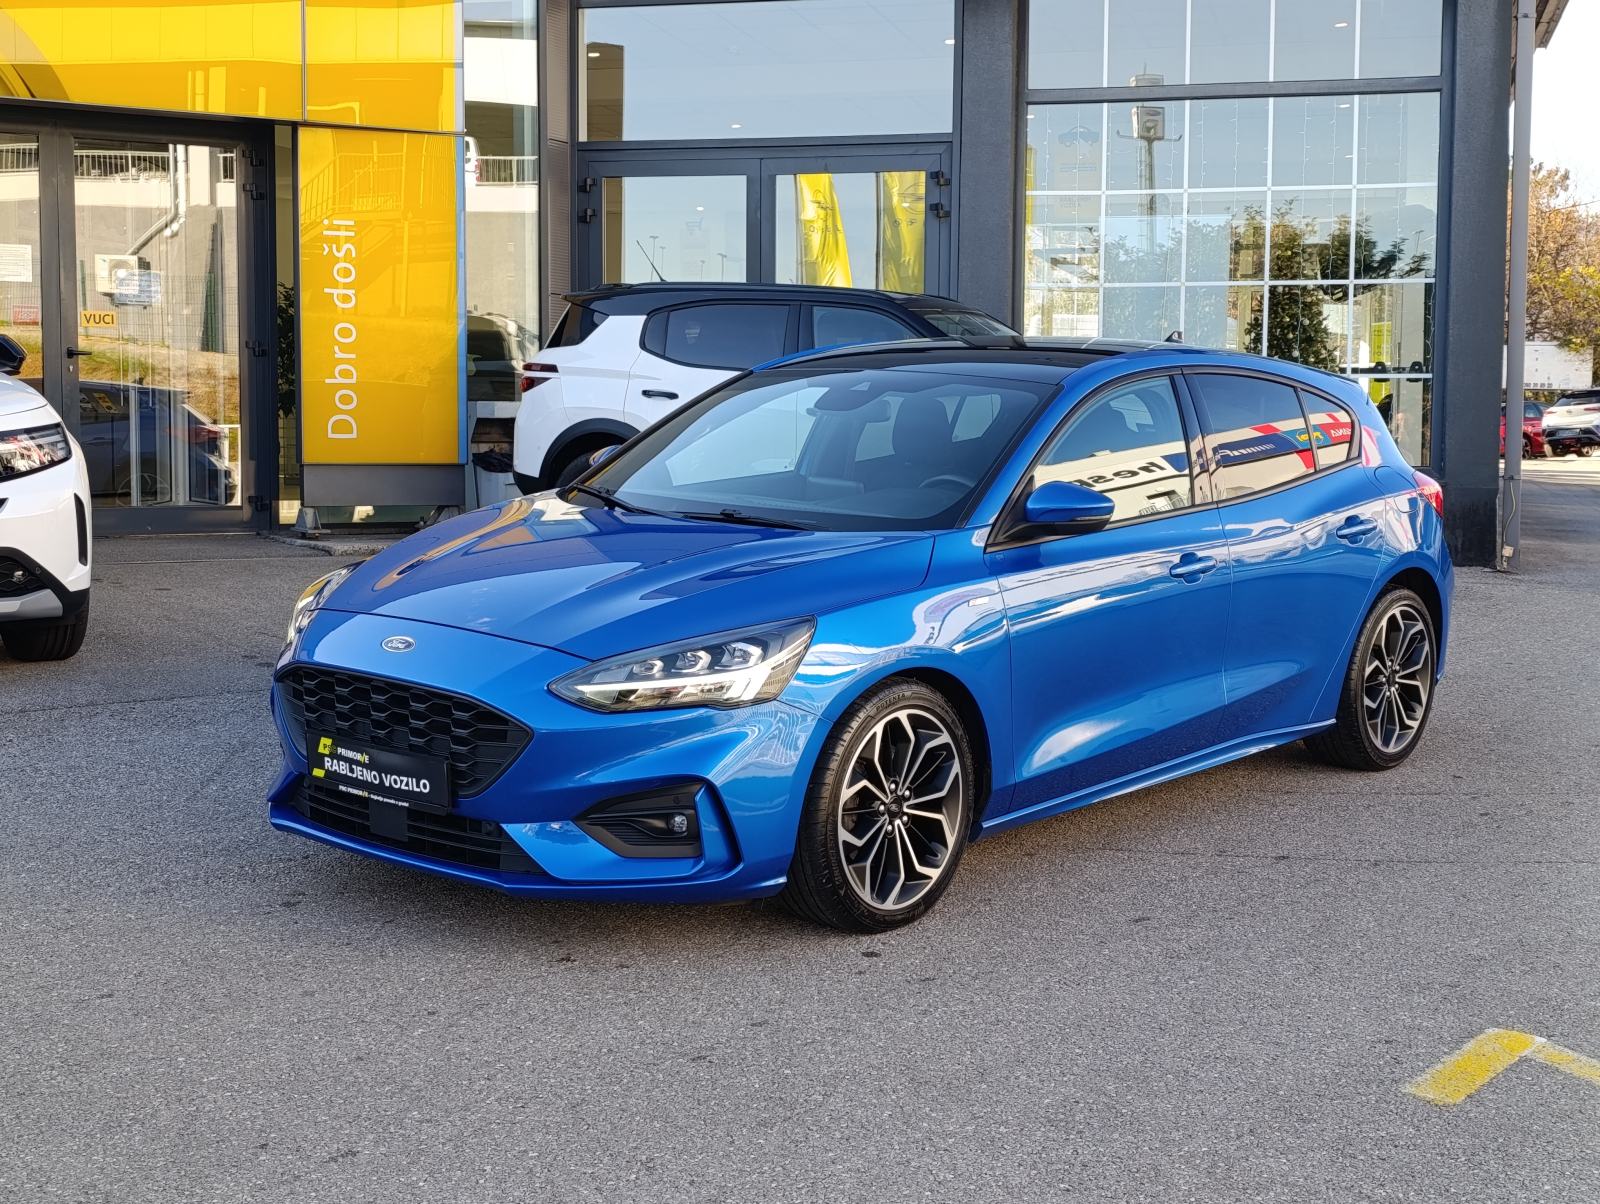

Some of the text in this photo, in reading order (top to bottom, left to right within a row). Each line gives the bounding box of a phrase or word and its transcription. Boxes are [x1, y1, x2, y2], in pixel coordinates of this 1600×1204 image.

[83, 313, 114, 325] VUCI
[322, 219, 358, 439] Dobro došli
[324, 756, 430, 794] RABLJENO VOZILO
